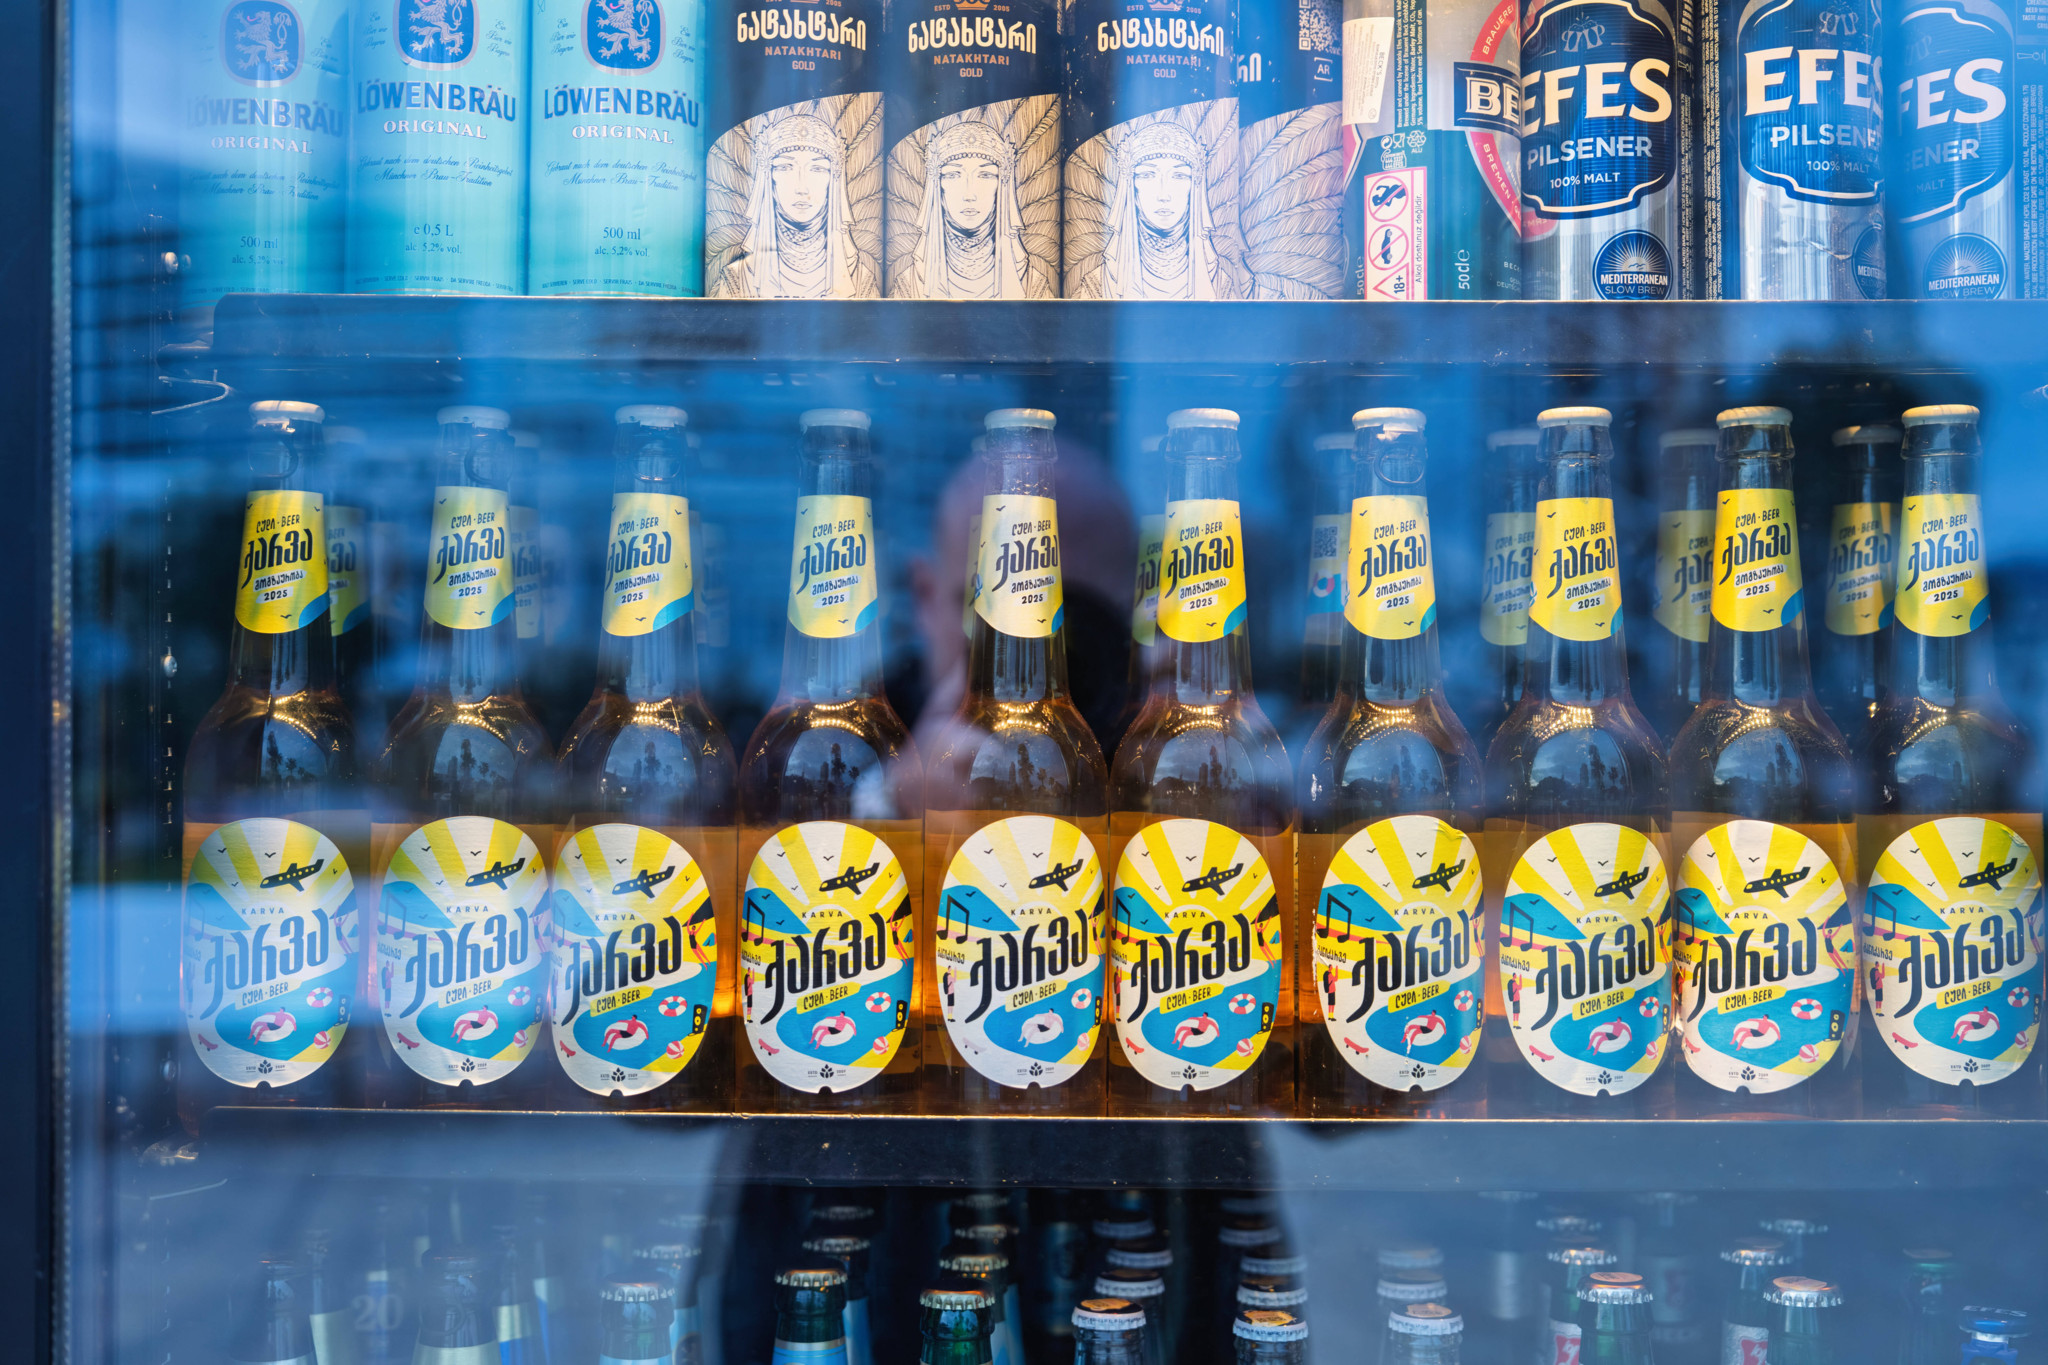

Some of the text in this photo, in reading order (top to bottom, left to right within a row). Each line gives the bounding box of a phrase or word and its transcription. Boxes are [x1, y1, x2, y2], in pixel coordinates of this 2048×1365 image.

[934, 4, 1010, 12] ESTD 2005
[1126, 4, 1144, 12] ESTD
[737, 8, 866, 51] ნატახტარი
[908, 16, 1036, 54] ნატახტარი
[1097, 17, 1224, 57] ნატახტარი
[764, 46, 841, 60] NATAKHTARI
[933, 53, 1010, 66] NATAKHTARI
[1126, 54, 1201, 68] NATAKHTARI
[792, 60, 815, 71] GOLD
[959, 68, 983, 77] GOLD
[1153, 68, 1177, 79] GOLD
[1316, 63, 1330, 75] AR
[357, 78, 516, 123] LÖWENBRÄU
[543, 83, 699, 128] LÖWENBRÄU
[1521, 58, 1672, 139] EFES
[383, 119, 487, 139] ORIGINAL
[572, 124, 674, 144] ORIGINAL
[210, 135, 313, 154] ORIGINAL
[1527, 136, 1653, 170] PILSENER
[1483, 143, 1511, 200] BREMEN
[1806, 160, 1870, 173] 100% MALT
[1550, 172, 1620, 189] 100% MALT
[423, 223, 454, 237] 0,5 L
[603, 226, 641, 240] 500 ml
[240, 236, 261, 249] 500
[422, 242, 445, 253] 5,2%
[1415, 227, 1423, 262] dostunuz
[595, 245, 650, 258] alc. 5,2% vol.
[1415, 263, 1423, 283] Alkol
[1600, 273, 1668, 286] MEDITERRANEAN
[1393, 275, 1405, 294] 18+
[1604, 285, 1665, 295] SLOW BREW
[1928, 274, 2000, 291] MEDITERRANEAN
[281, 514, 300, 528] BEER
[477, 512, 495, 525] BEER
[640, 516, 659, 530] BEER
[1762, 508, 1780, 522] BEER
[1949, 514, 1968, 528] BEER
[838, 519, 856, 532] BEER
[1037, 520, 1051, 532] BEER
[1205, 521, 1223, 535] BEER
[1400, 519, 1417, 533] BEER
[1590, 521, 1606, 535] BEER
[241, 528, 313, 590] ქარვა
[433, 526, 505, 585] ქარვა
[605, 531, 672, 592] ქარვა
[1719, 522, 1792, 586] ქარვა
[1905, 527, 1980, 592] ქარვა
[796, 533, 867, 595] ქარვა
[992, 534, 1058, 592] ქარვა
[1164, 535, 1234, 599] ქარვა
[1358, 534, 1427, 598] ქარვა
[1546, 535, 1616, 599] ქარვა
[263, 589, 288, 602] 2025
[458, 586, 482, 597] 2025
[1745, 583, 1770, 596] 2025
[1933, 589, 1959, 603] 2025
[621, 592, 643, 604] 2025
[821, 594, 845, 606] 2025
[1021, 593, 1044, 605] 2025
[1189, 597, 1213, 610] 2025
[1386, 595, 1410, 608] 2025
[1577, 597, 1601, 610] 2025
[241, 907, 285, 915] KARVA
[446, 905, 489, 913] KARVA
[594, 913, 636, 921] KARVA
[1010, 908, 1052, 916] KARVA
[1164, 911, 1206, 919] KARVA
[1393, 907, 1436, 916] KARVA
[1724, 912, 1769, 920] KARVA
[1576, 915, 1618, 924] KARVA
[200, 907, 329, 1021] ქარვა
[399, 906, 529, 1019] ქარვა
[760, 912, 886, 1025] ქარვა
[964, 908, 1089, 1024] ქარვა
[1127, 913, 1251, 1024] ქარვა
[1346, 909, 1470, 1024] ქარვა
[1686, 916, 1817, 1023] ქარვა
[1893, 907, 2025, 1020] ქარვა
[561, 915, 682, 1027] ქარვა
[1530, 916, 1656, 1032] ქარვა
[269, 981, 289, 997] BEER
[473, 979, 492, 995] BEER
[830, 985, 849, 1002] BEER
[1039, 982, 1057, 999] BEER
[1192, 986, 1212, 1002] BEER
[1421, 983, 1440, 1000] BEER
[1972, 980, 1992, 997] BEER
[621, 989, 641, 1005] BEER
[1606, 990, 1625, 1008] BEER
[1752, 988, 1773, 1004] BEER
